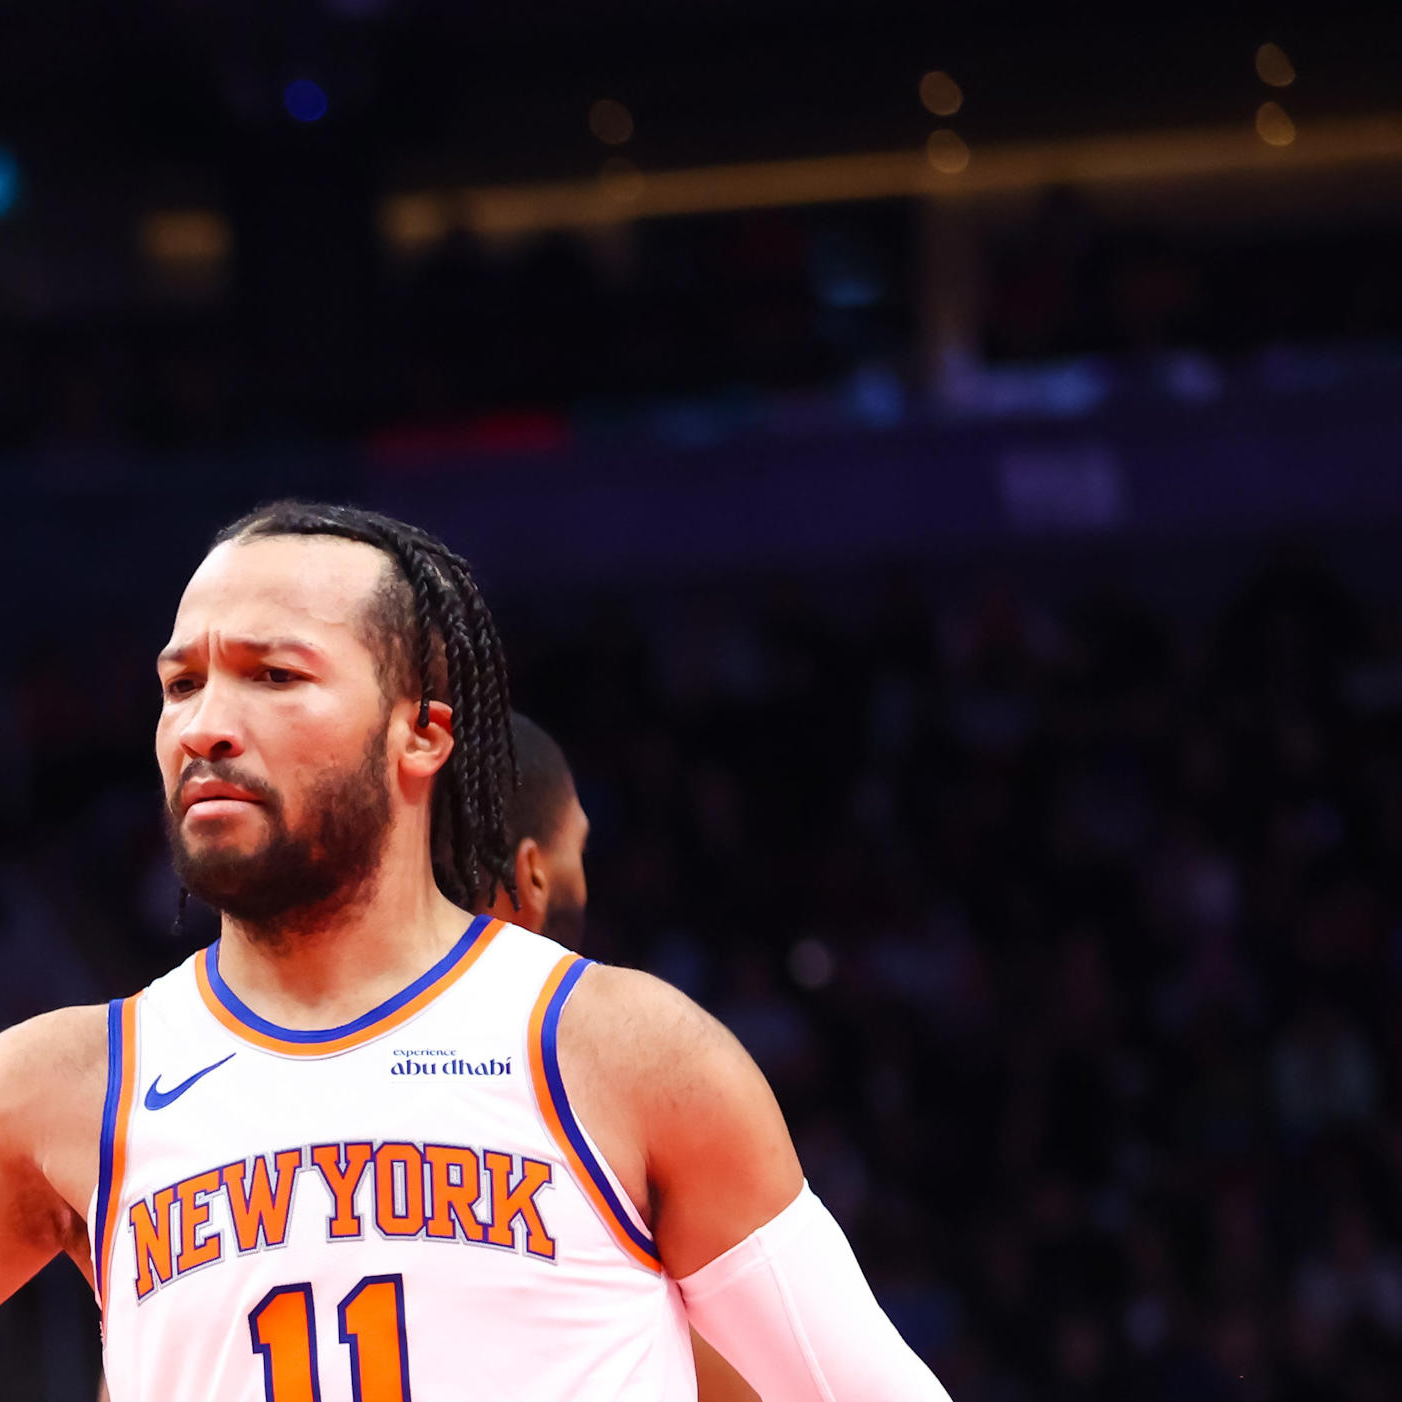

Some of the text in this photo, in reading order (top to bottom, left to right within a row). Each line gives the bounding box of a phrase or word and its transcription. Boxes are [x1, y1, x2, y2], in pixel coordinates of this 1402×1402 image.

[393, 1048, 457, 1058] experience
[390, 1056, 512, 1076] abu dhabi
[128, 1139, 559, 1305] NEW YORK
